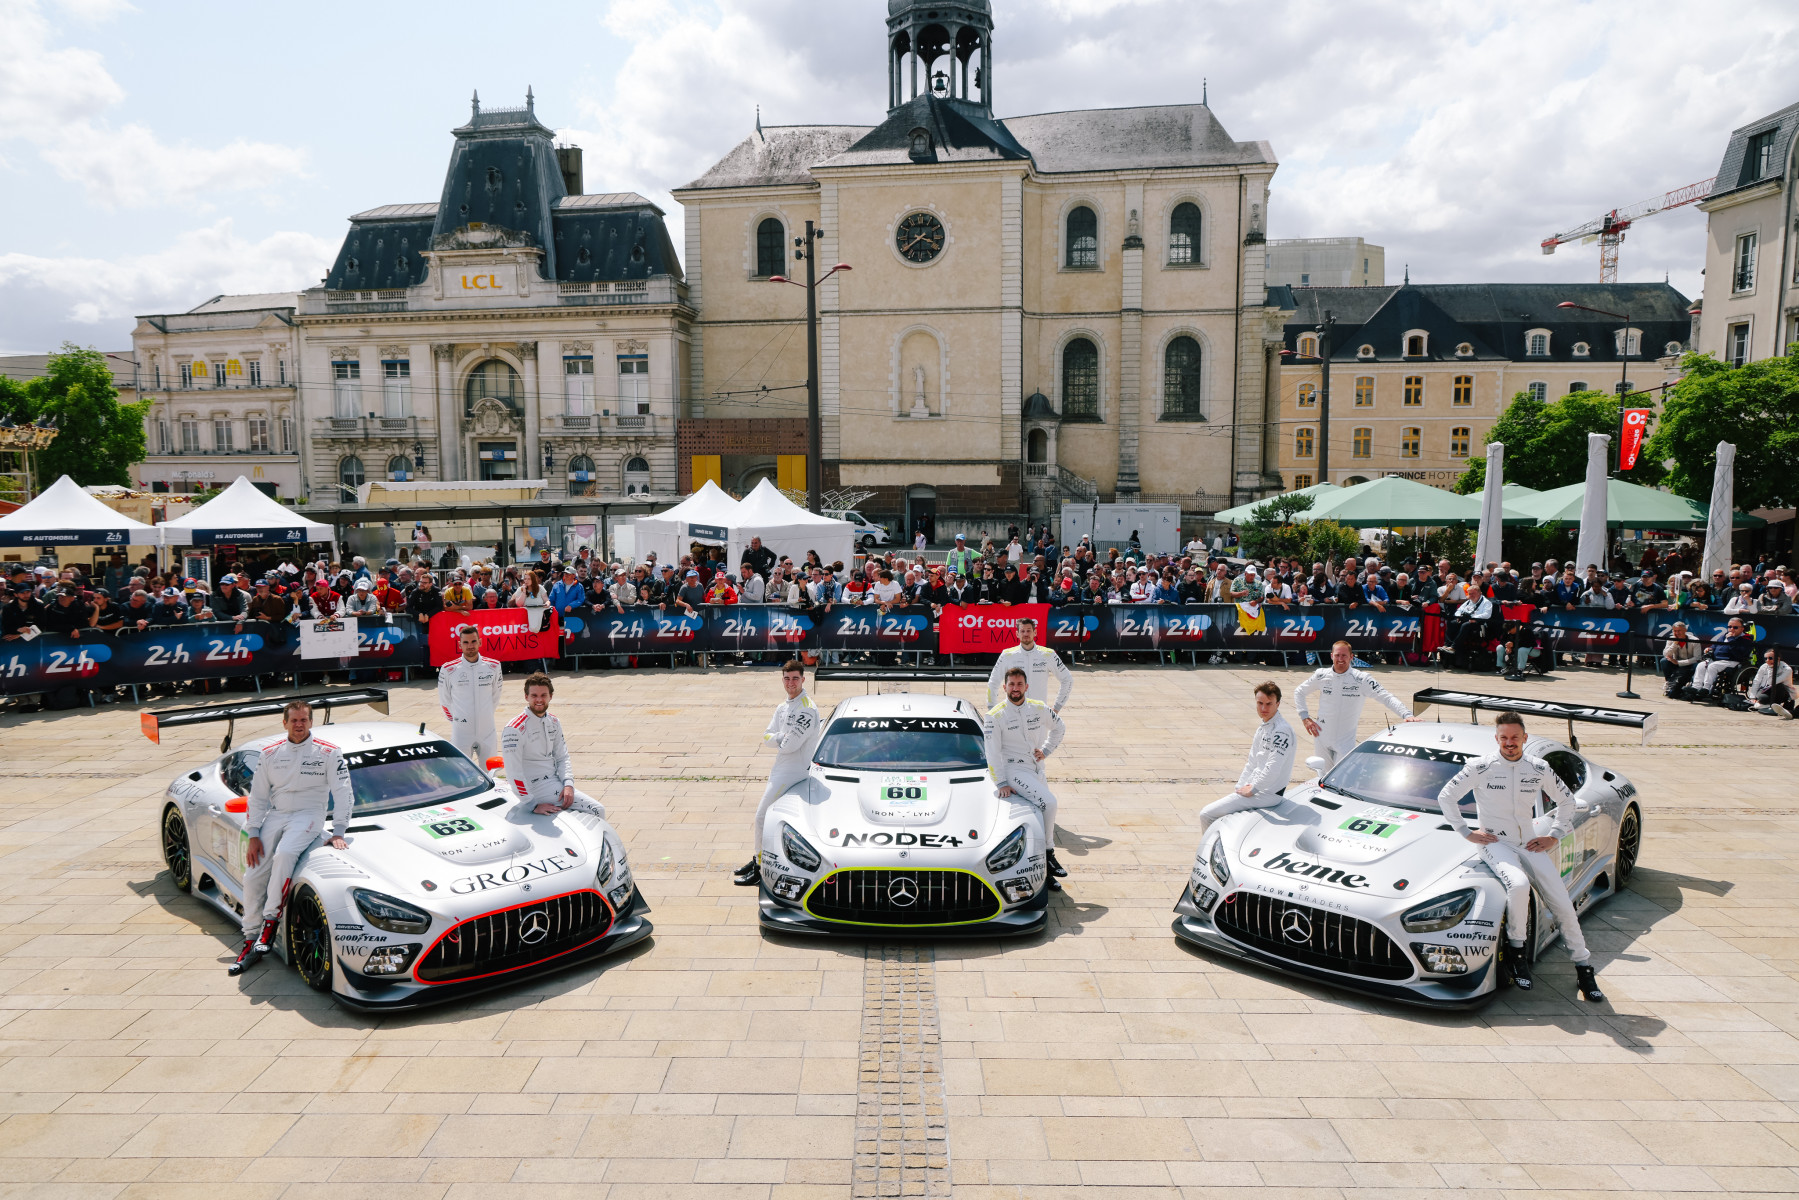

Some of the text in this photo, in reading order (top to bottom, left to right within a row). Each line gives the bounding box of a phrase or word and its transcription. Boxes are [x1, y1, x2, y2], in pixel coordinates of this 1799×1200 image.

[461, 275, 503, 289] LCL
[1428, 471, 1459, 480] HOTE
[330, 602, 336, 610] B
[482, 623, 530, 636] cours
[608, 620, 645, 638] 24h
[657, 619, 692, 637] 24h
[722, 619, 757, 637] 24h
[769, 618, 803, 636] 24h
[837, 618, 871, 635] 24h
[882, 618, 916, 636] 24h
[987, 618, 1038, 628] cou
[1120, 618, 1154, 636] 24h
[1166, 618, 1201, 636] 24h
[1280, 619, 1314, 637] 24h
[1345, 619, 1378, 637] 24h
[486, 634, 538, 652] MANS
[963, 629, 1038, 643] LE MA
[145, 643, 190, 666] 24h
[206, 639, 249, 660] 24h
[46, 650, 95, 674] 24h
[921, 721, 959, 729] LYNX
[397, 745, 439, 757] LYNX
[1378, 744, 1418, 756] IRON
[887, 787, 922, 799] 60
[871, 809, 894, 817] IRON
[430, 819, 476, 836] 63
[1347, 818, 1390, 836] 61
[439, 838, 507, 857] IRON LYNX
[842, 832, 963, 848] NODE4
[1317, 833, 1388, 853] IRON LYNX
[450, 856, 573, 895] GROVE
[1256, 884, 1350, 911] FLOW TRADERS
[334, 933, 388, 943] GOODYEAR
[1446, 931, 1497, 942] GOODYEAR
[341, 945, 369, 958] IWC
[1464, 946, 1490, 957] IWC
